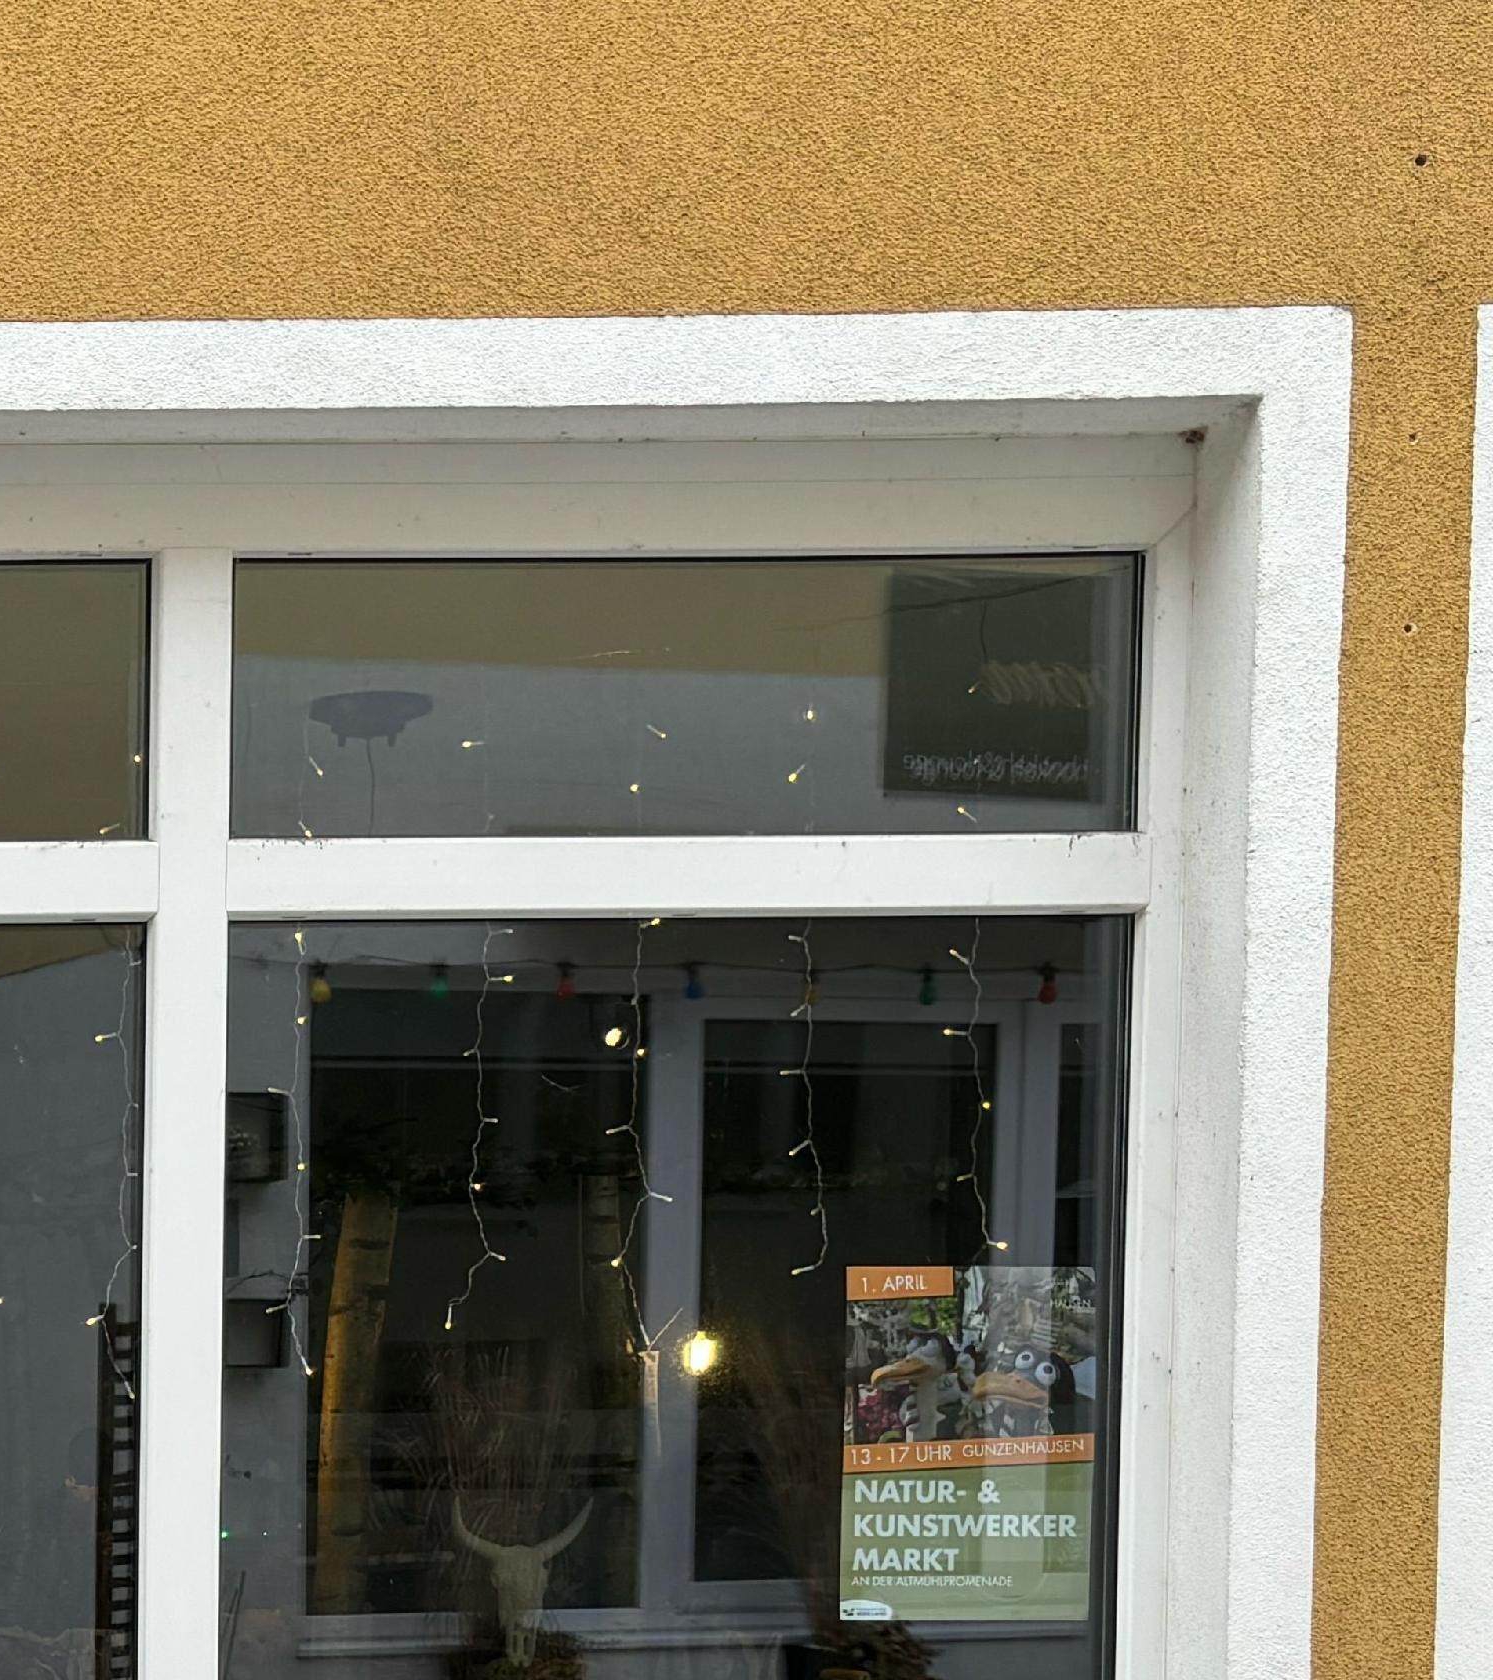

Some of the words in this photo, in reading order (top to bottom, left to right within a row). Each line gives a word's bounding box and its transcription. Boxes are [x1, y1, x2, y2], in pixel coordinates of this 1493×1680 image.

[881, 1273, 929, 1293] APRIL
[850, 1448, 872, 1465] 13
[889, 1447, 909, 1464] 17
[916, 1446, 952, 1464] UHR
[962, 1439, 1085, 1459] GUNZENHAUSEN
[853, 1479, 967, 1503] NATUR-
[977, 1479, 1001, 1503] &
[853, 1513, 1078, 1538] KUNSTWERKER
[852, 1547, 960, 1572] MARKT
[851, 1575, 870, 1586] AN
[872, 1575, 894, 1586] DER
